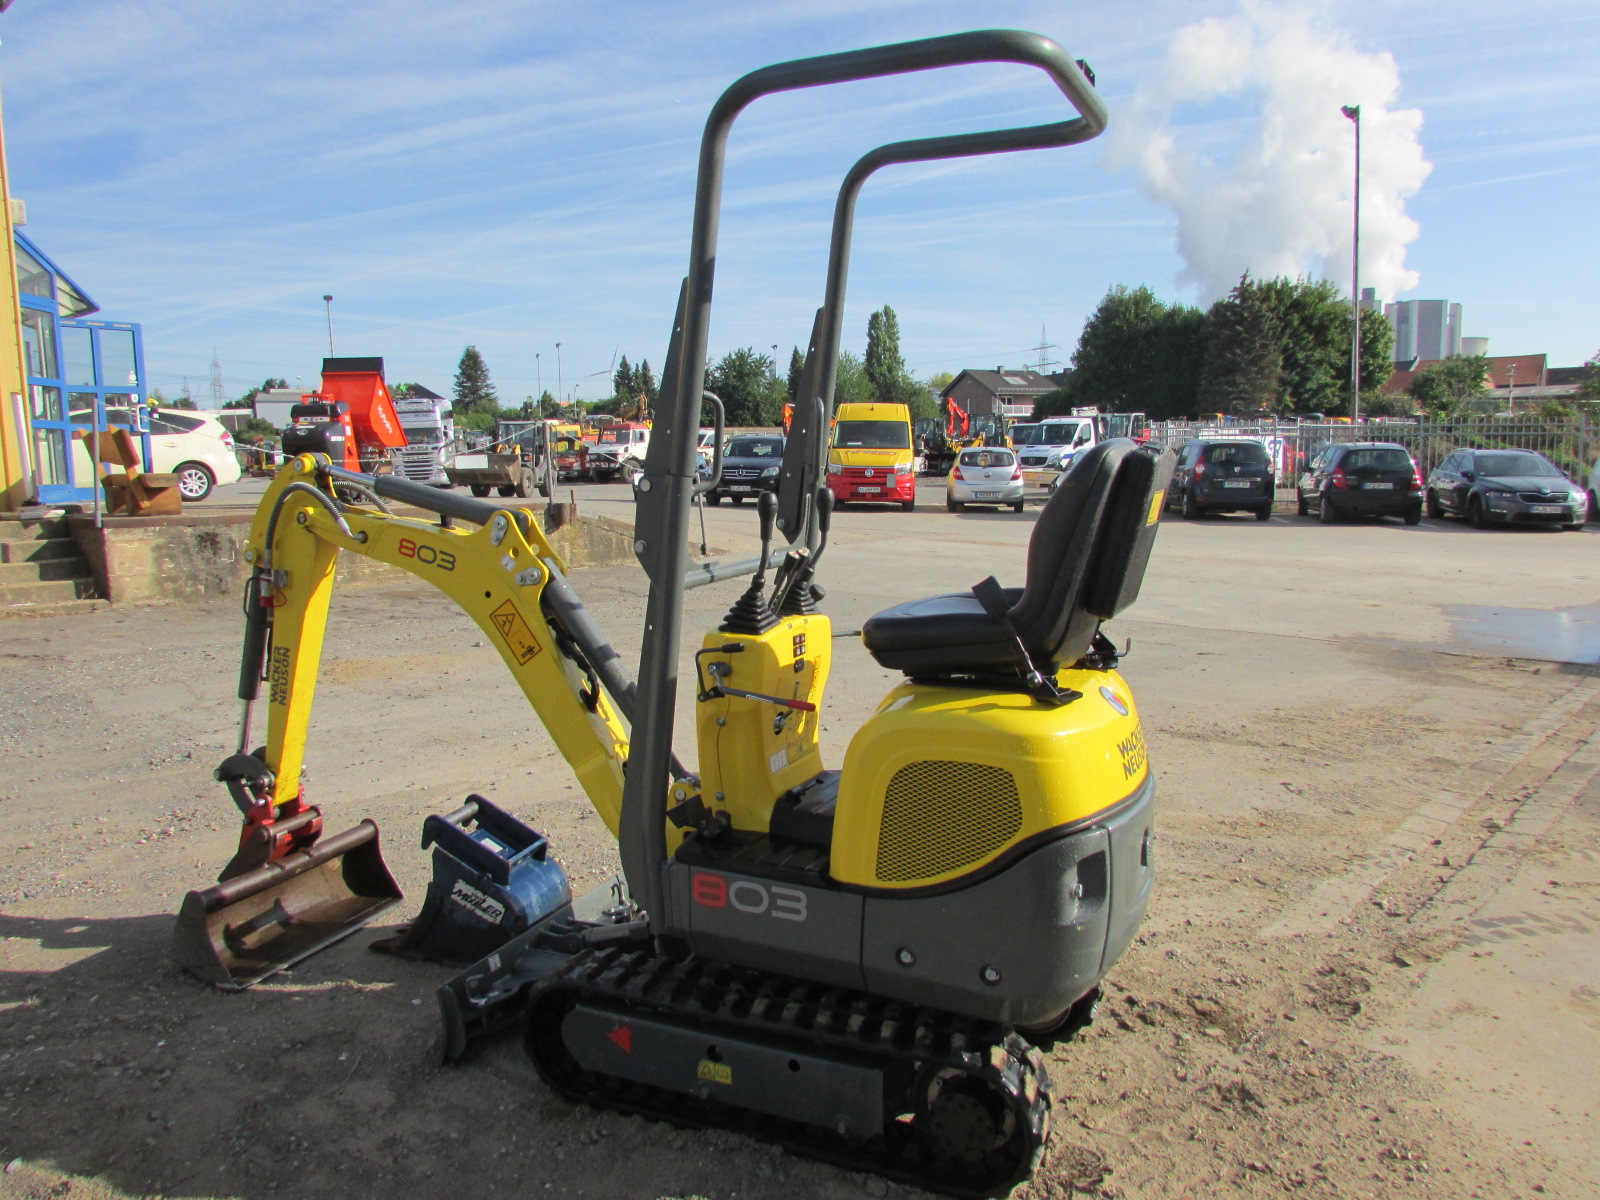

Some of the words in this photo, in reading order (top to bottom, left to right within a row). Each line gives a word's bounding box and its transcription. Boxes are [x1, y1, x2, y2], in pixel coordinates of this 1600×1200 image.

[398, 537, 456, 572] 803
[270, 645, 283, 703] WACKER
[278, 647, 290, 706] NEUSON
[693, 872, 808, 922] 803
